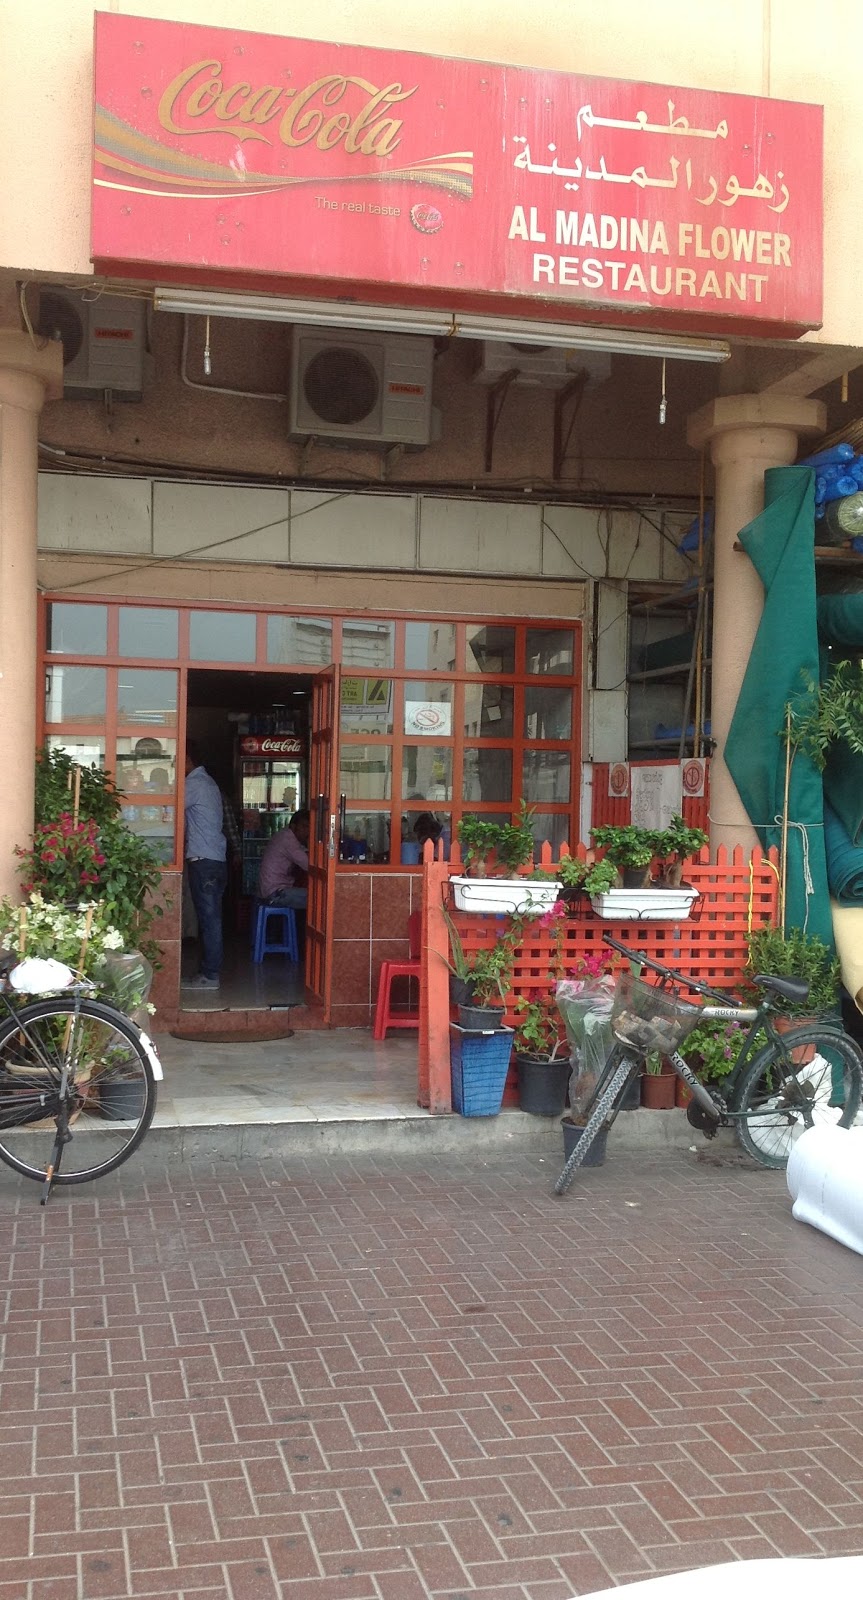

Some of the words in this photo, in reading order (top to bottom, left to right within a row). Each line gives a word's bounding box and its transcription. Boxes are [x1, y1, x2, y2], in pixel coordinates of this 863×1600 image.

[157, 59, 419, 157] Coca-Cola
[577, 99, 728, 141] مطعم
[513, 135, 693, 191] المدينة
[315, 196, 338, 210] The
[341, 201, 366, 213] real
[368, 203, 401, 217] taste
[695, 170, 790, 213] زهور
[508, 205, 546, 242] AL
[555, 209, 669, 256] MADINA
[678, 222, 792, 267] FLOWER
[533, 253, 769, 303] RESTAURANT
[261, 738, 301, 752] Coca-Cola
[671, 1053, 698, 1086] ROCKY
